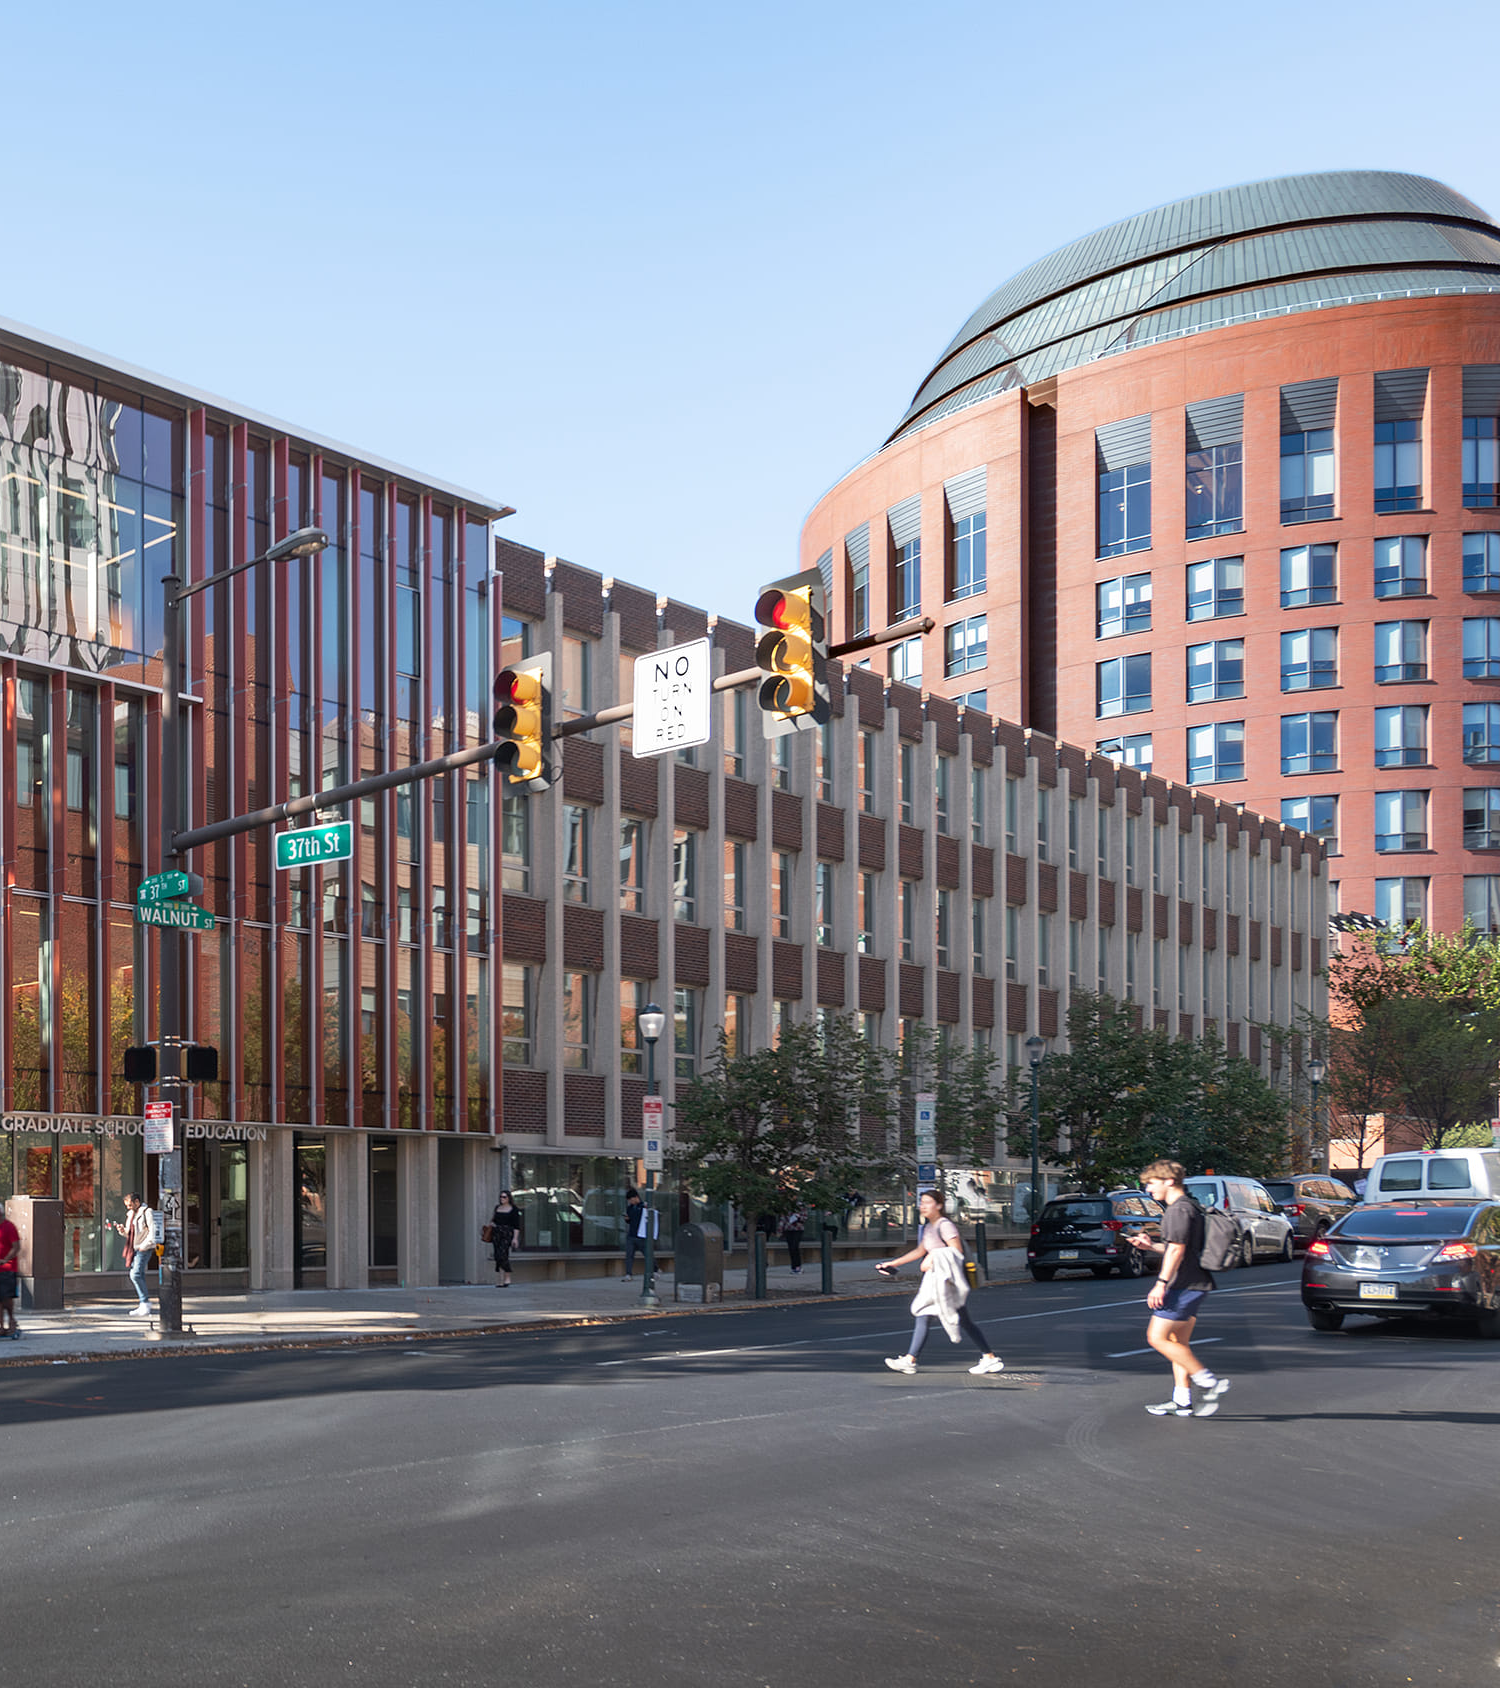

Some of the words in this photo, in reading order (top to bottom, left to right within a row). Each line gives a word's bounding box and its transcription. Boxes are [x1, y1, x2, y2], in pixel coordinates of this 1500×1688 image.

[655, 656, 689, 682] NO
[652, 683, 692, 702] TURN
[660, 705, 683, 721] ON
[656, 723, 685, 741] RED
[287, 836, 320, 860] 37th
[324, 832, 340, 854] St
[178, 879, 185, 891] ST
[140, 907, 199, 927] WALNUT
[204, 918, 212, 928] ST
[1, 1116, 91, 1133] GRADUATE
[94, 1120, 145, 1136] SCHOO
[186, 1124, 267, 1141] EDUCATION
